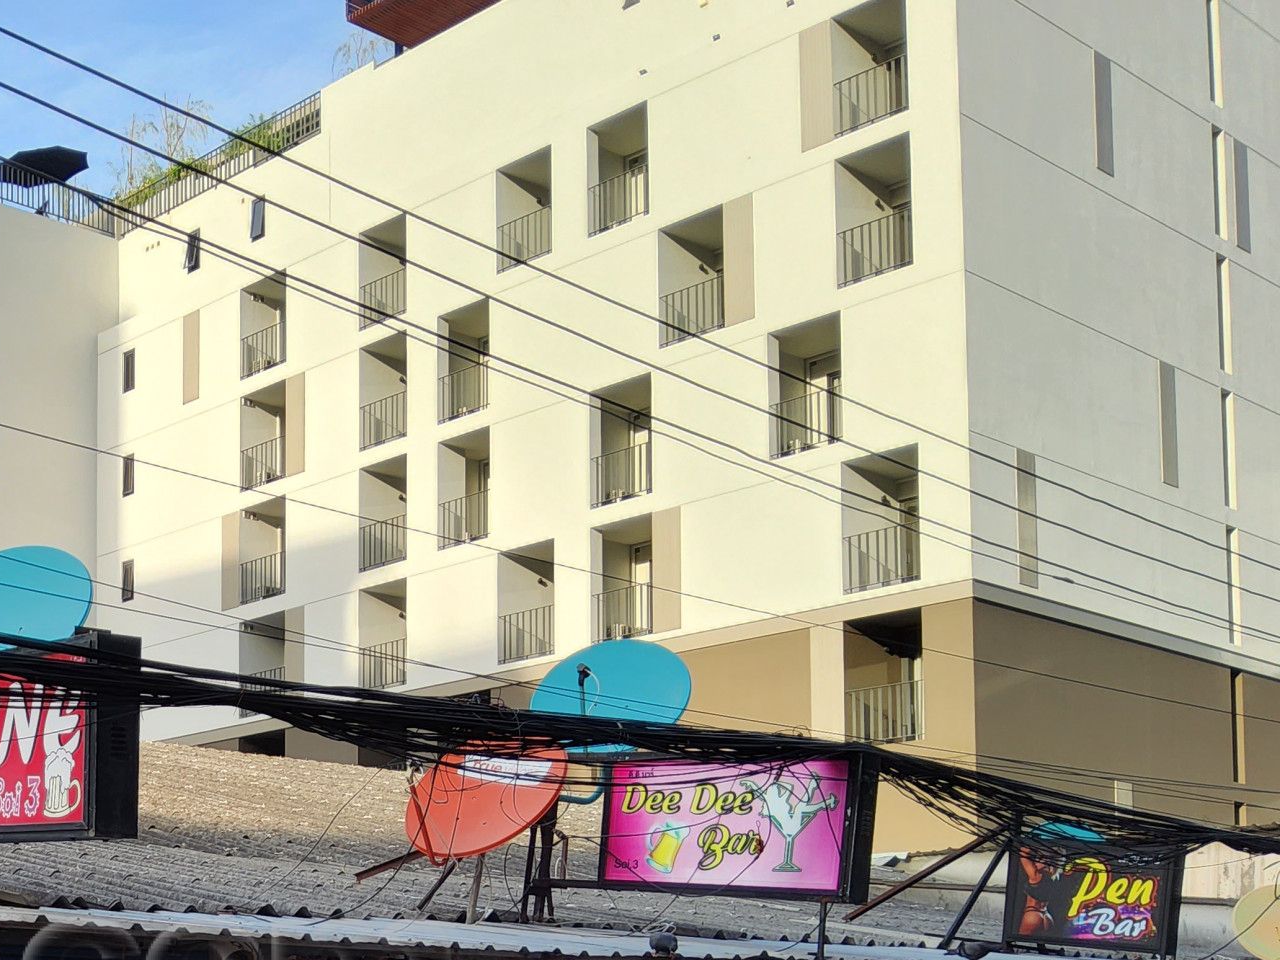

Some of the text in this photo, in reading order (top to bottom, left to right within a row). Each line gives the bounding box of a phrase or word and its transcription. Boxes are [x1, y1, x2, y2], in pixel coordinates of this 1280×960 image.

[24, 775, 41, 817] 3
[621, 783, 754, 815] Dee Dee
[697, 823, 761, 870] Bar
[1065, 857, 1154, 917] Pen
[1087, 907, 1147, 937] Bar
